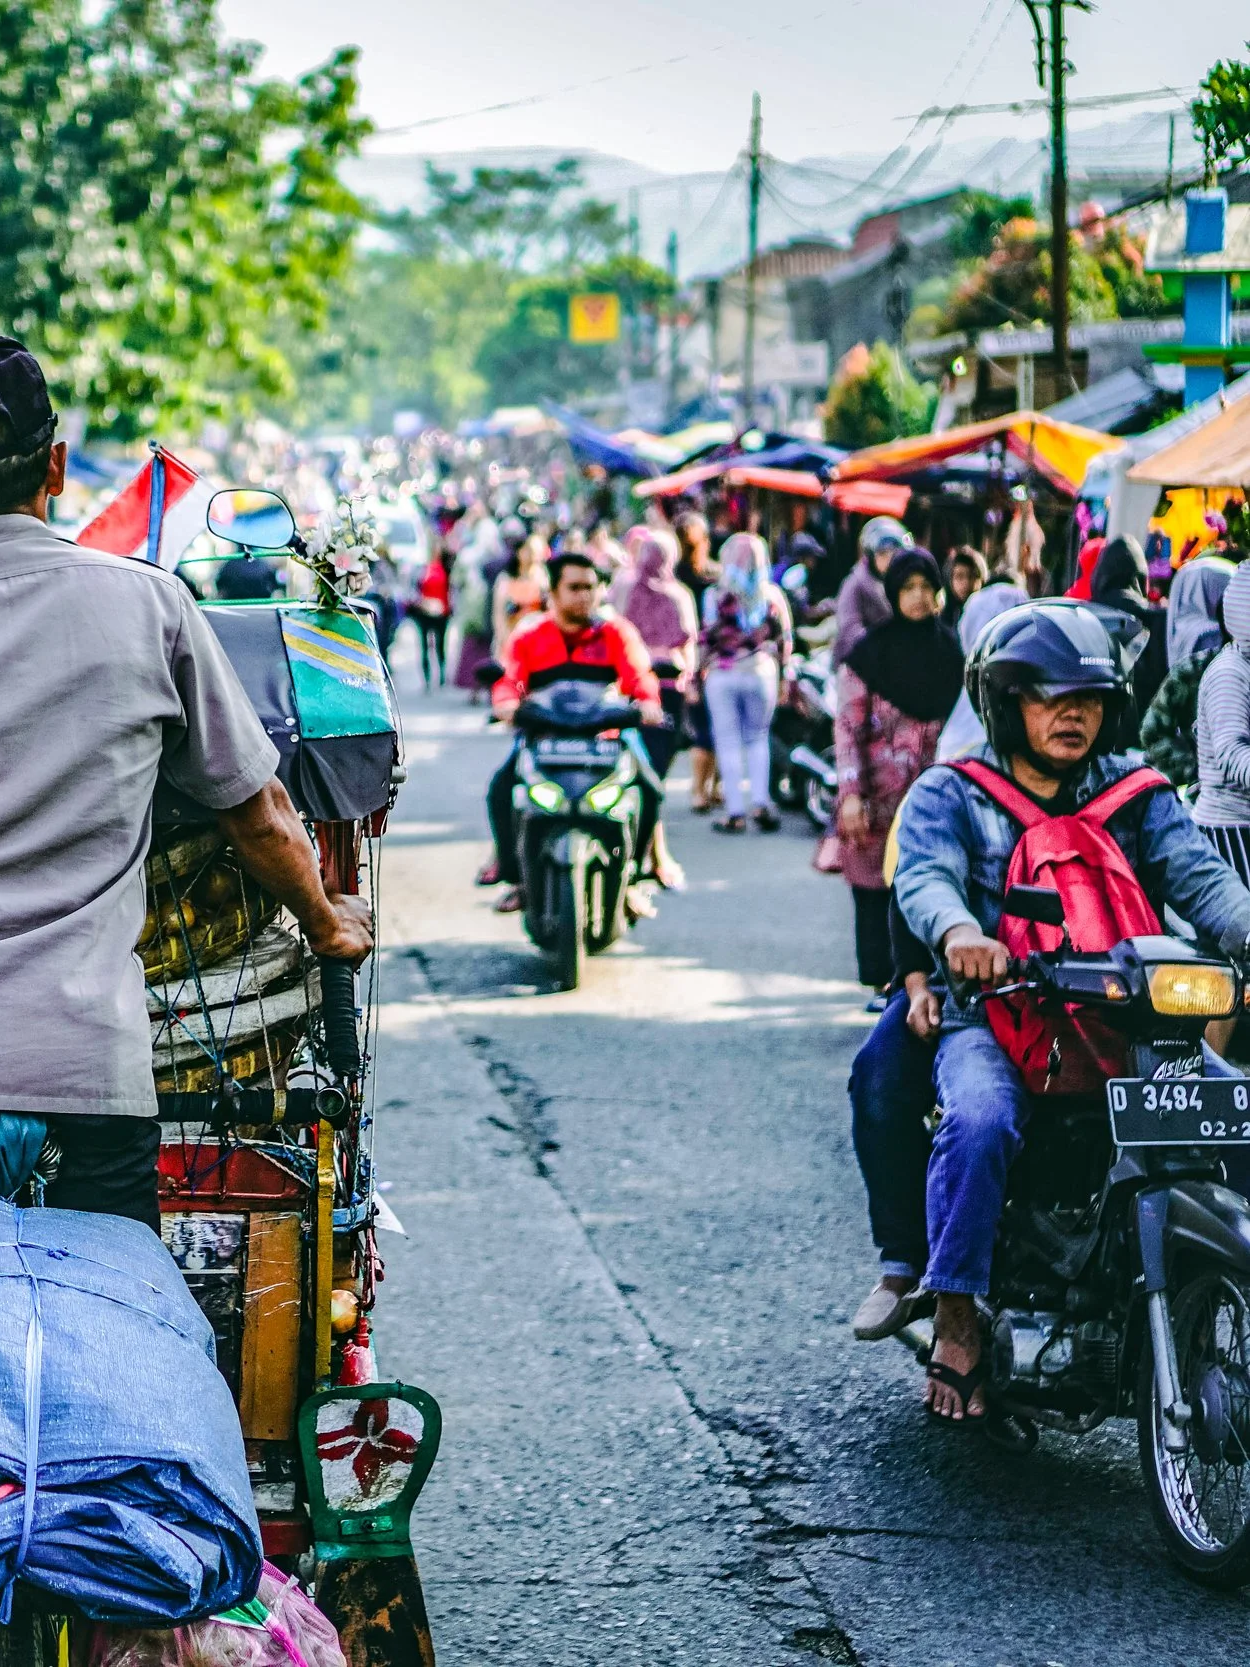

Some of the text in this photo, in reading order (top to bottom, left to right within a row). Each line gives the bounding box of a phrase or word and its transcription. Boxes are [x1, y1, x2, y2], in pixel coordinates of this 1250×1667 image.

[1079, 656, 1116, 667] HONDA
[1112, 1085, 1128, 1113] D
[1142, 1084, 1203, 1112] 3484
